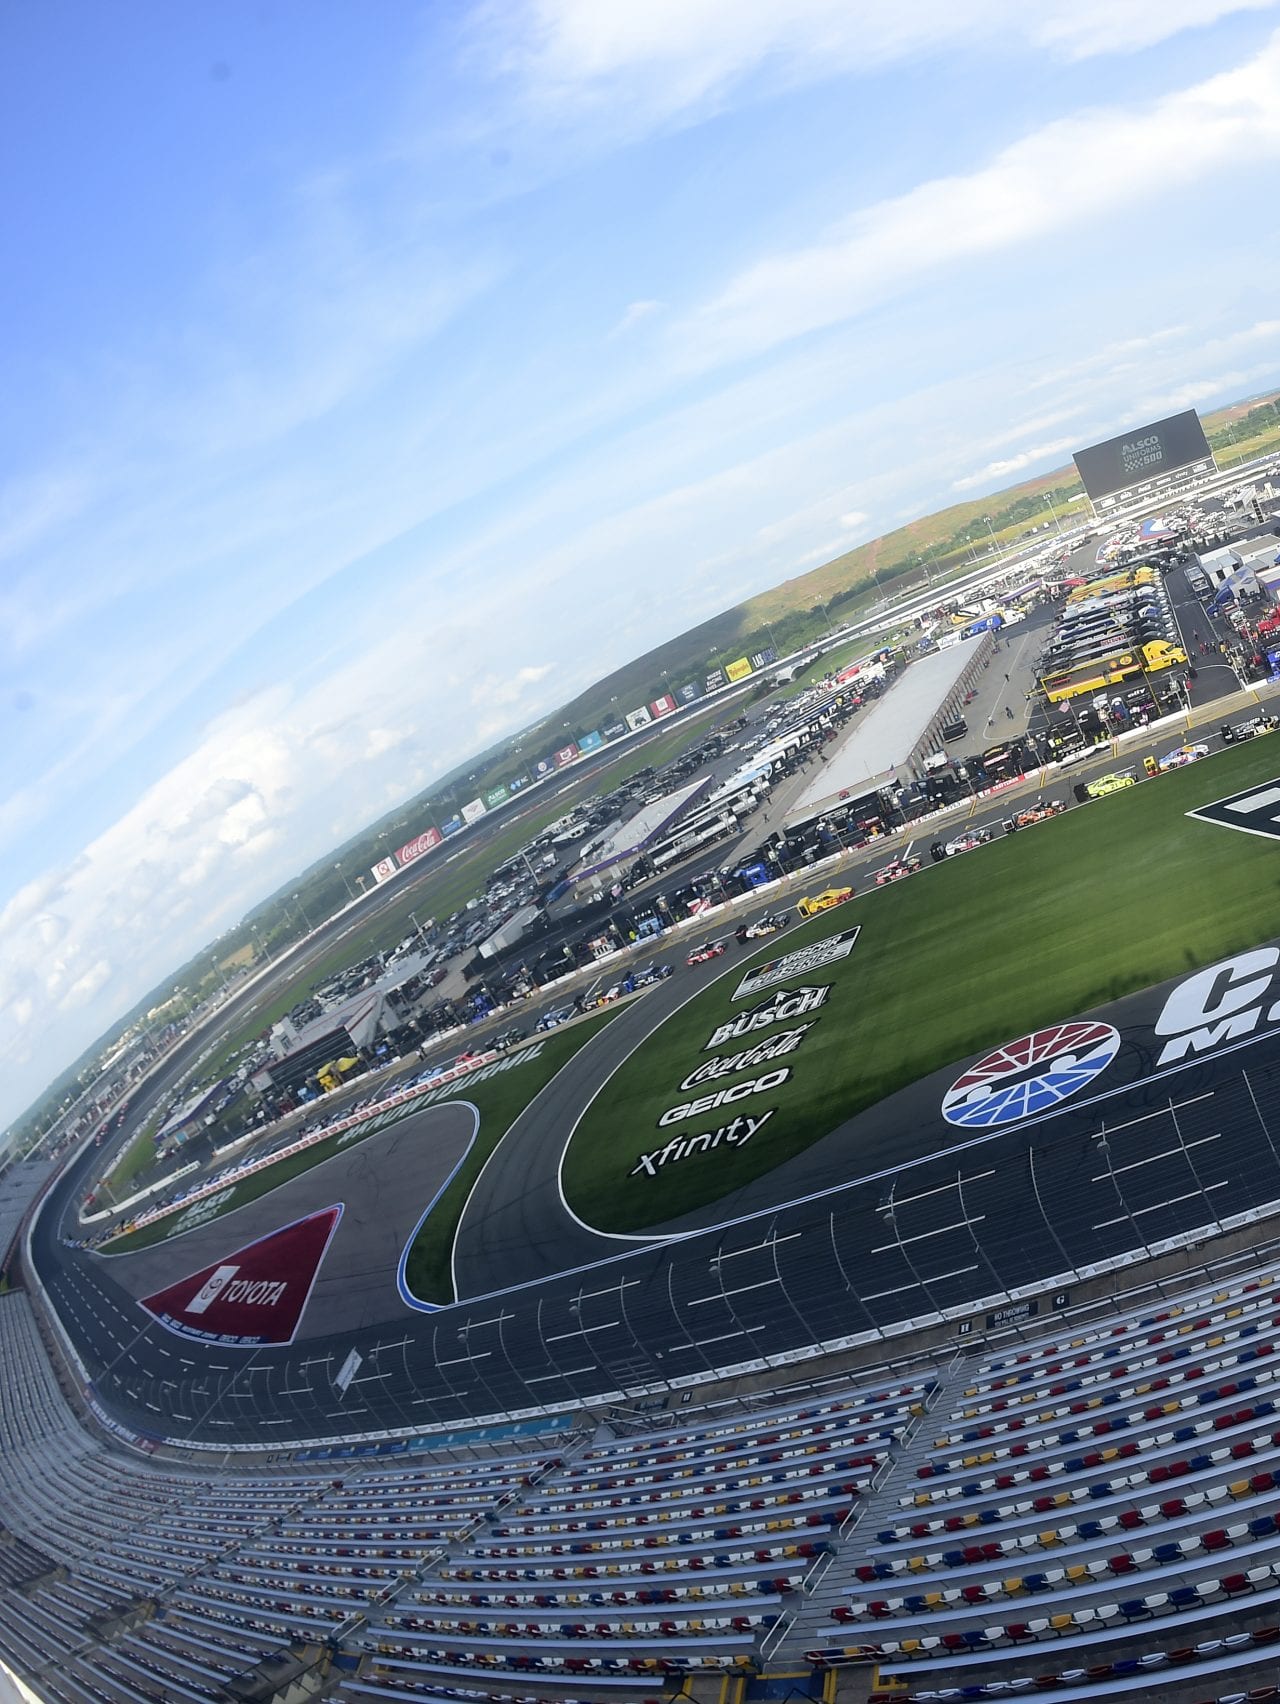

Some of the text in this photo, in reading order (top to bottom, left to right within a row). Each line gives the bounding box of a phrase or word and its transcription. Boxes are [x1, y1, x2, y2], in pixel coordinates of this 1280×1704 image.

[1121, 435, 1159, 455] ALSCO
[1123, 443, 1162, 462] UNIFORMS
[402, 830, 436, 862] Coca-Cola
[776, 935, 842, 968] NASCAR
[704, 985, 830, 1051] BUSCH
[680, 1020, 818, 1091] Coca-Cola
[659, 1067, 790, 1127] GEICO
[631, 1110, 775, 1176] xfinity
[221, 1280, 288, 1307] TOYOTA
